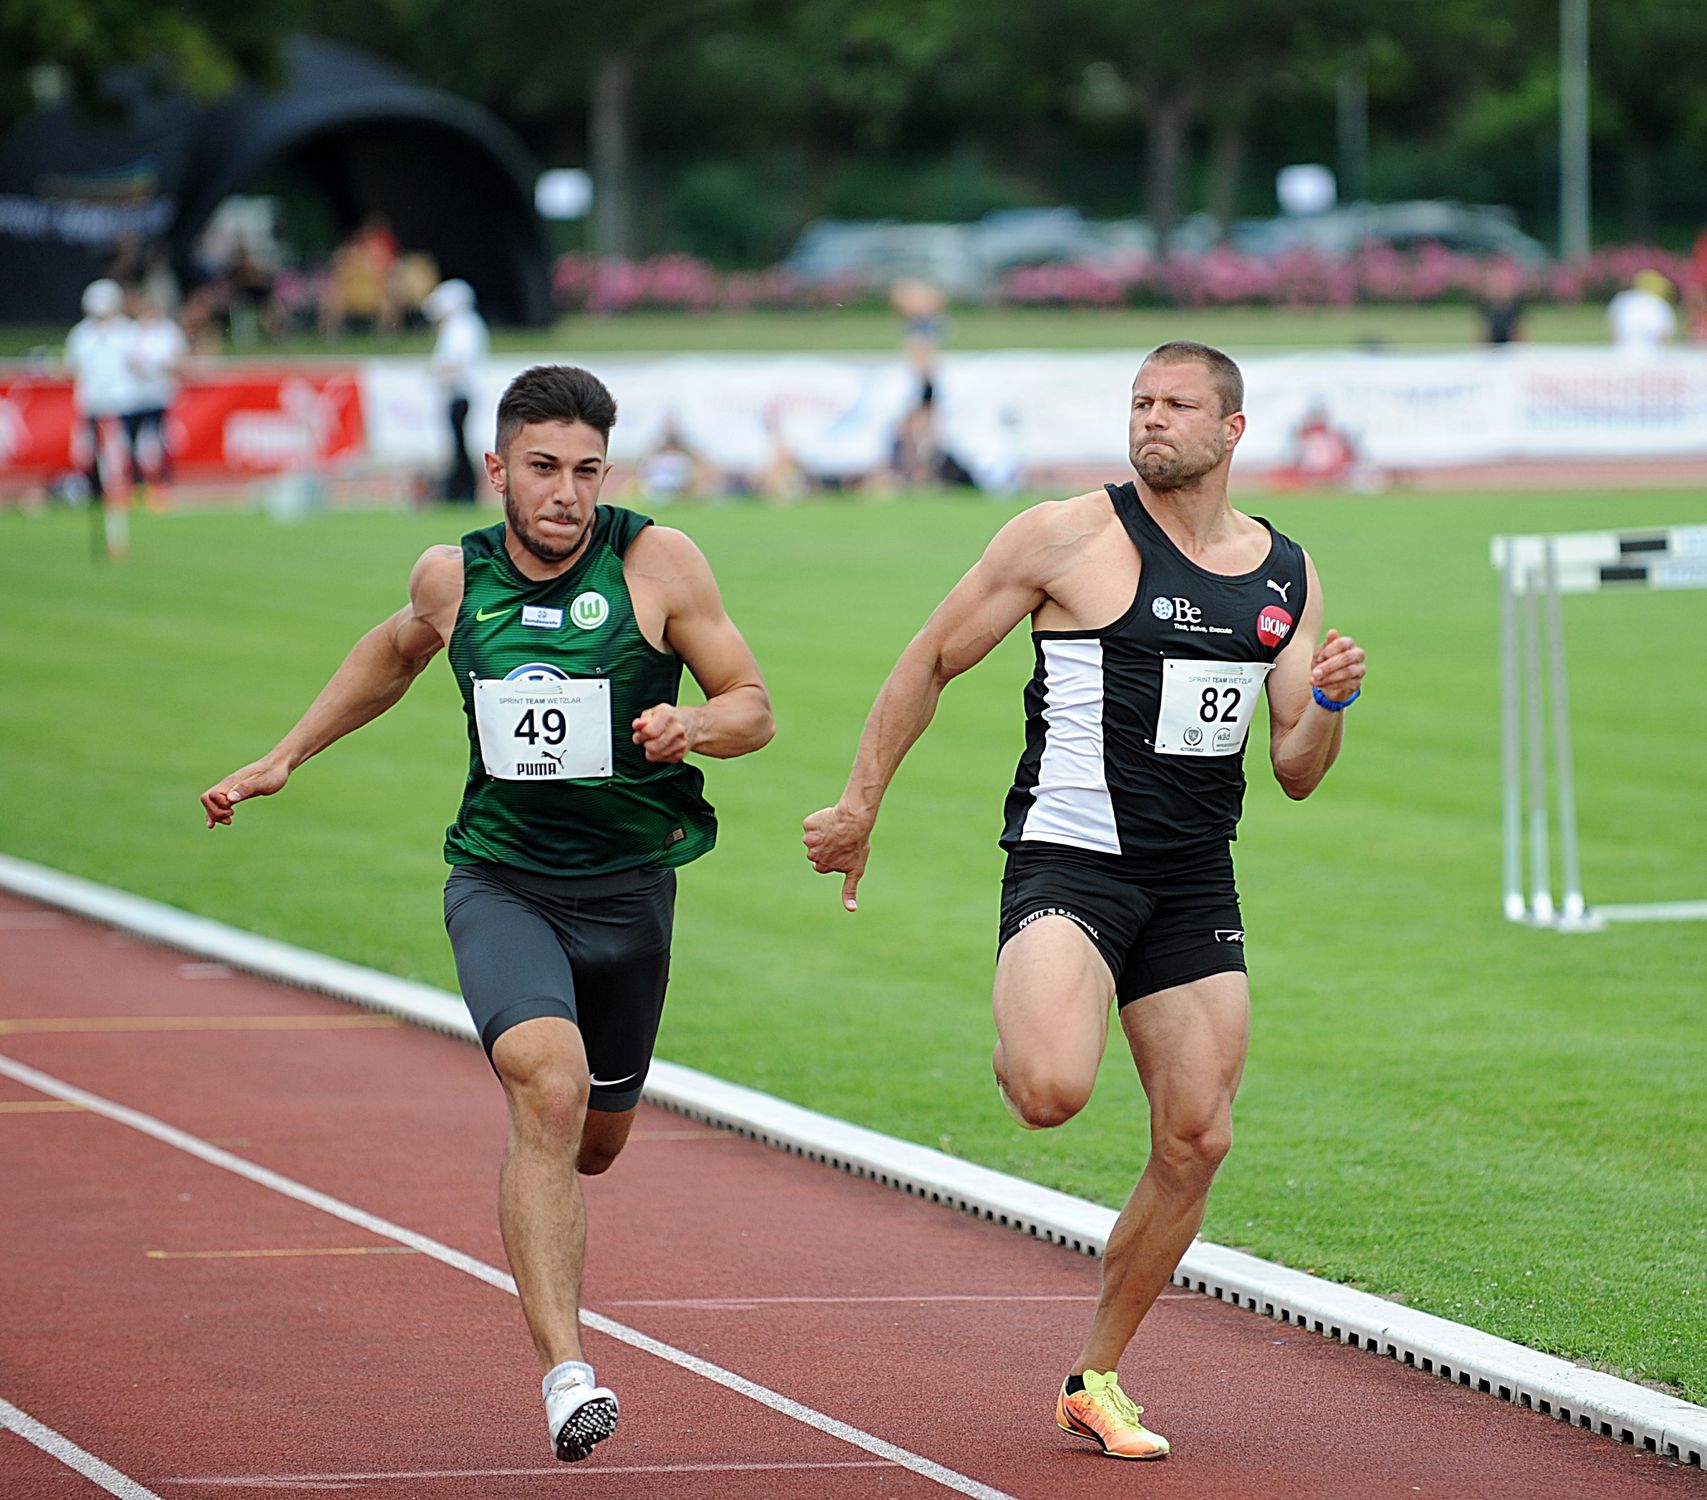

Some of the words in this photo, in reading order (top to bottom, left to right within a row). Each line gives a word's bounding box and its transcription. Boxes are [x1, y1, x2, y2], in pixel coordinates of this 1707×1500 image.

[1172, 597, 1202, 623] Be
[1188, 675, 1211, 683] SPRINT
[499, 697, 524, 705] SPRINT
[1199, 687, 1241, 723] 82
[514, 708, 567, 745] 49
[517, 763, 557, 776] PUMA
